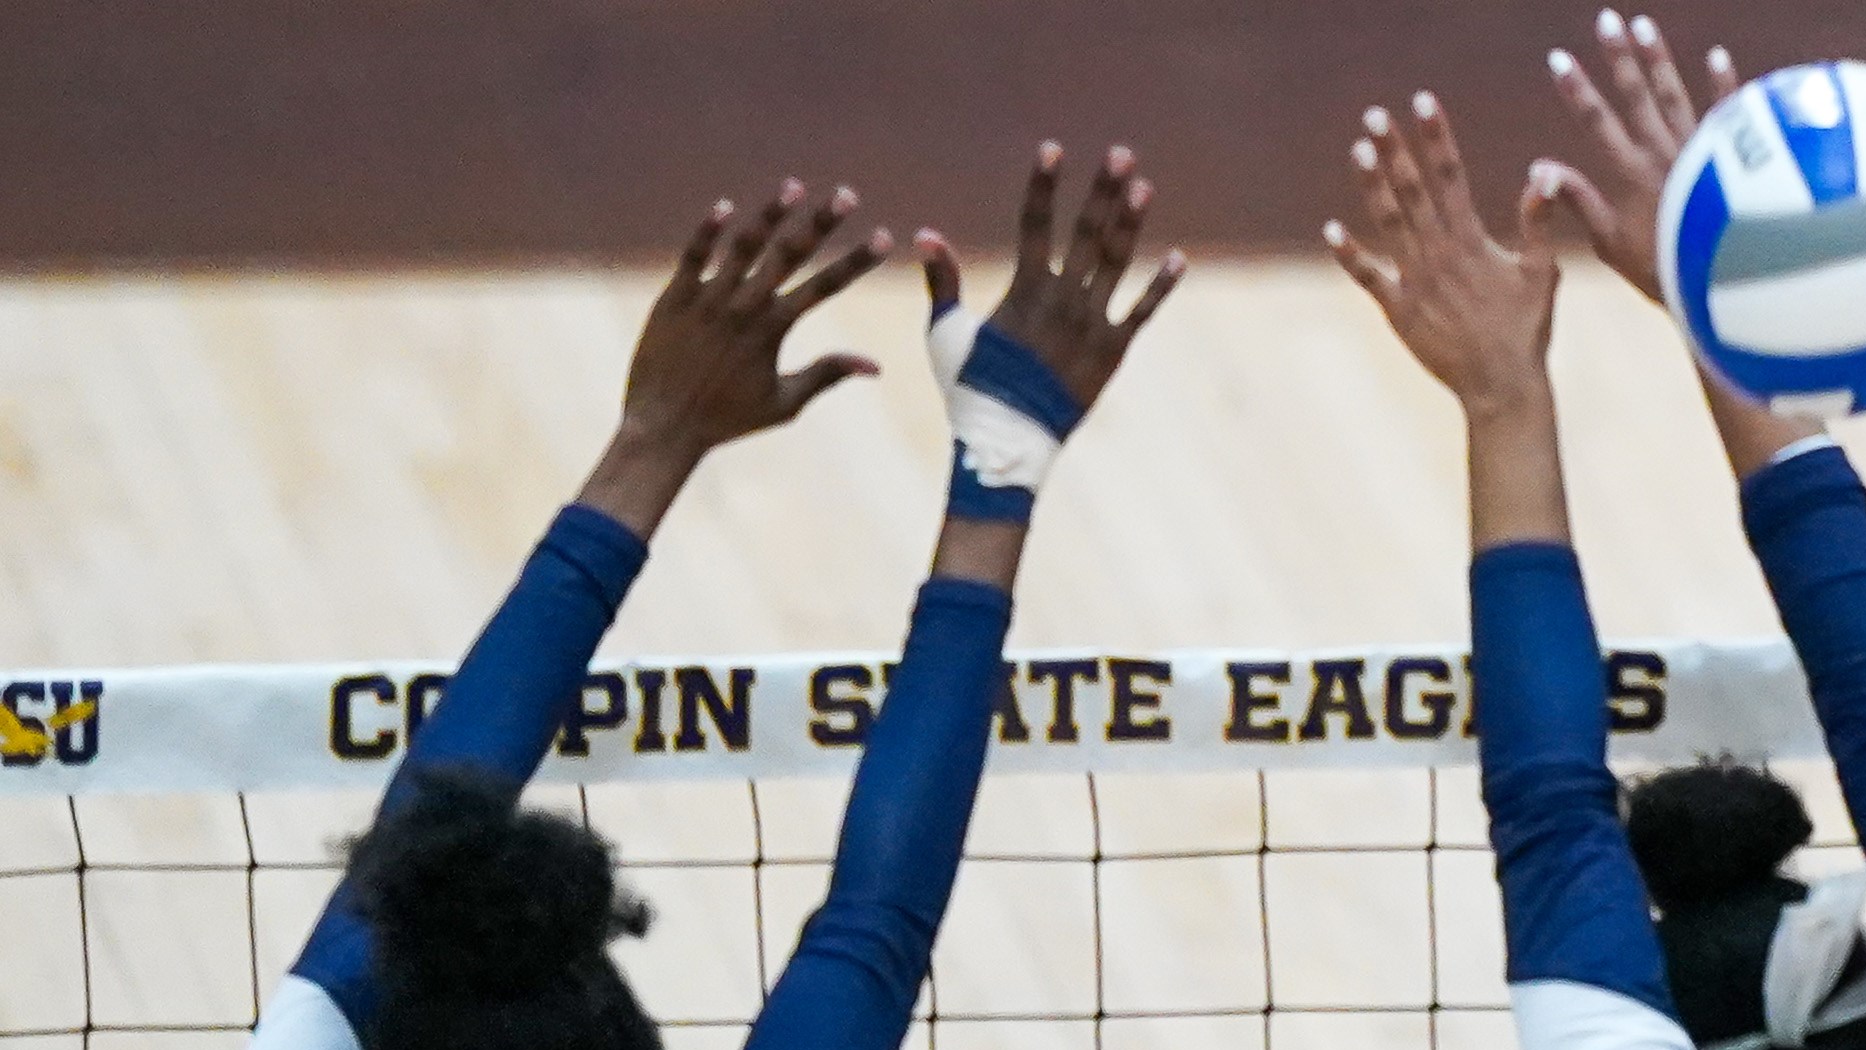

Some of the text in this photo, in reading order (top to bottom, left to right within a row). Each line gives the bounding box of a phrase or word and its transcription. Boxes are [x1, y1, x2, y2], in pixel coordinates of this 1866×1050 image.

[1, 680, 103, 766] SU
[329, 649, 1668, 760] CPIN STE EAGS
